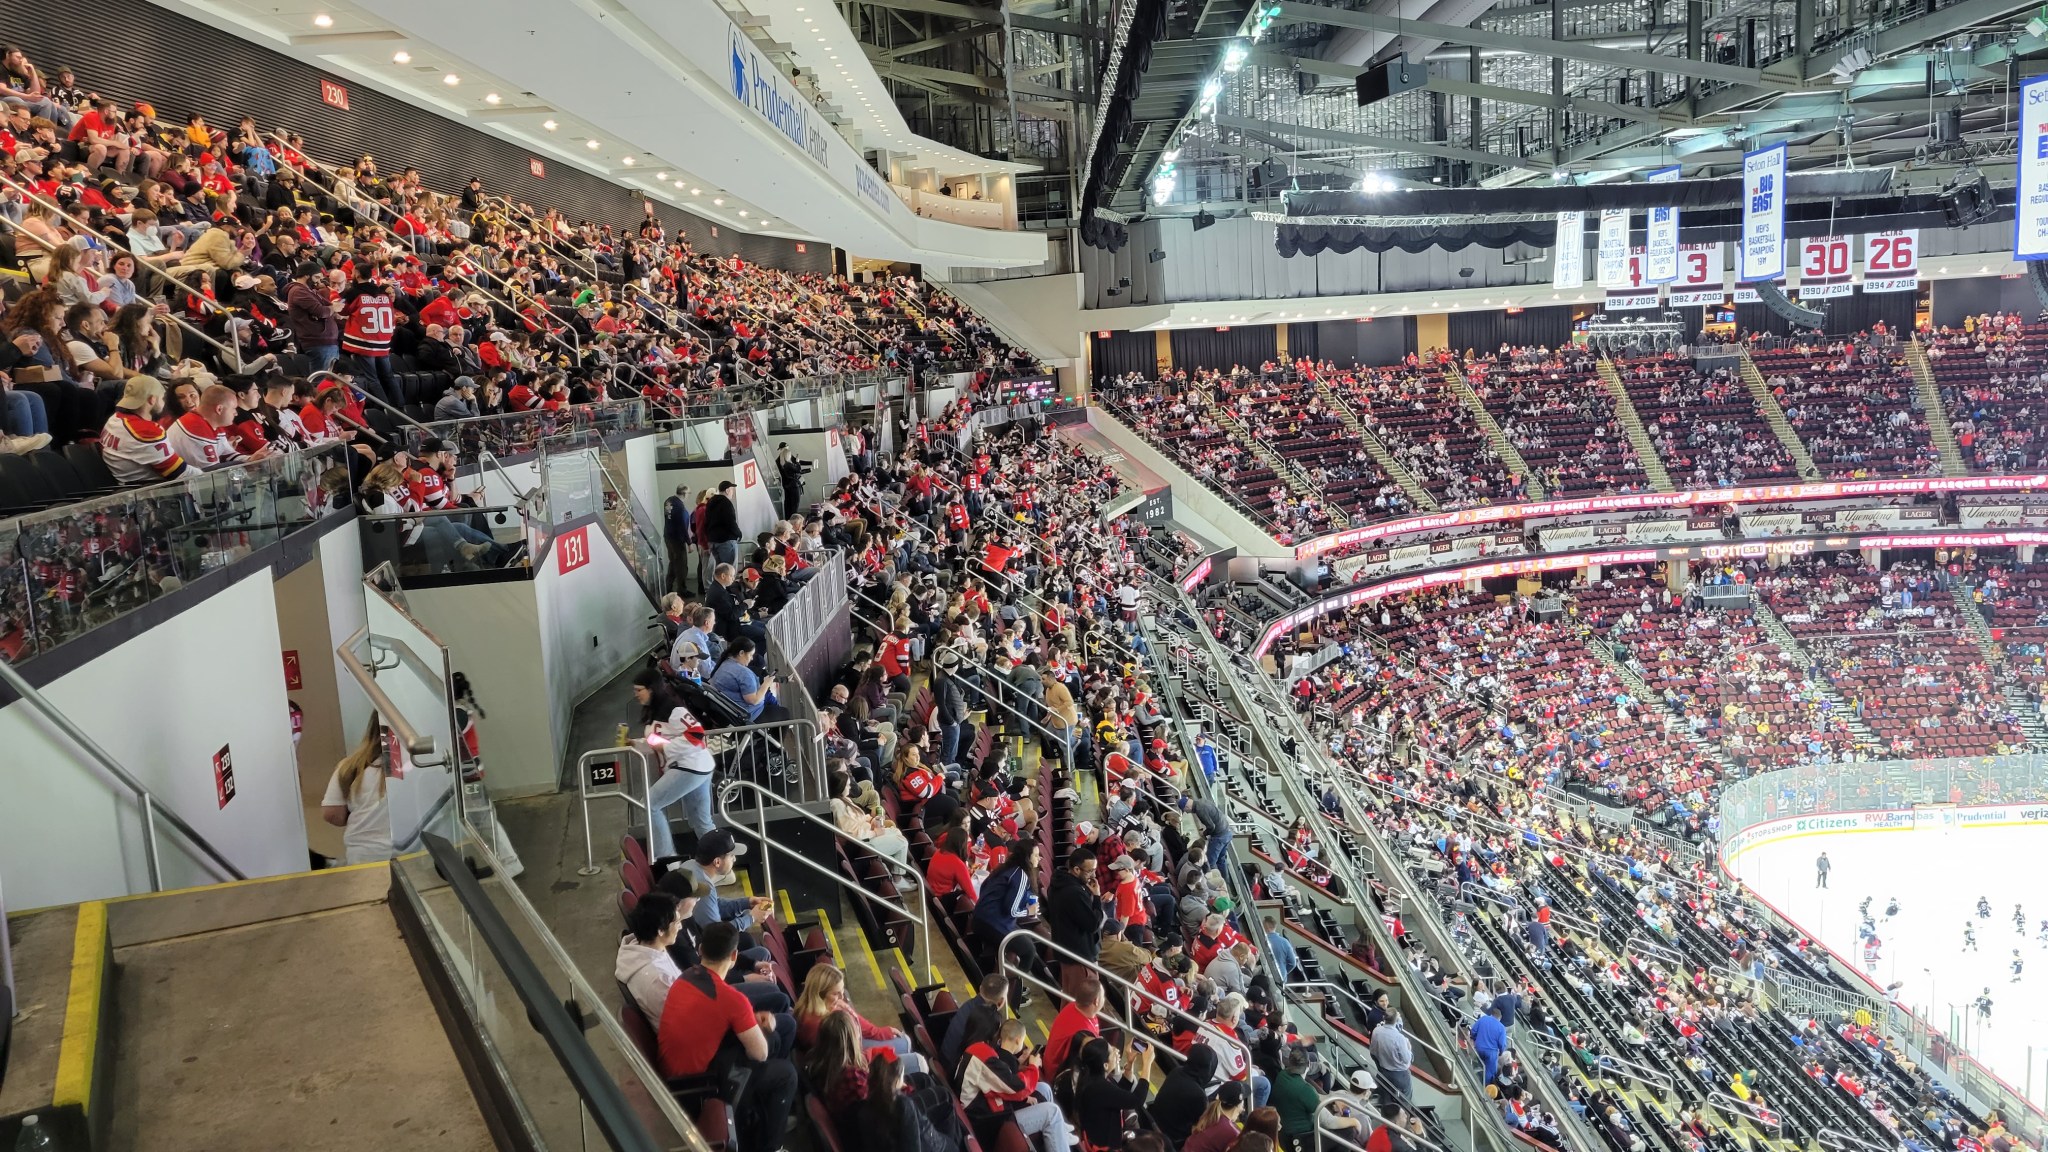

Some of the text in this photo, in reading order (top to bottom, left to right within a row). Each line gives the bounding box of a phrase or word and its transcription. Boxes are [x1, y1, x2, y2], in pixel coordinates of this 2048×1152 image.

[326, 85, 344, 105] 230
[750, 53, 829, 169] Prudential Center
[1747, 153, 1781, 173] Seton Hall
[1760, 174, 1774, 193] BIG
[1752, 193, 1773, 213] EAST
[1655, 207, 1671, 222] EAST
[1748, 235, 1776, 246] BASKETBALL
[1805, 242, 1848, 276] 30
[1870, 236, 1913, 270] 26
[1687, 253, 1708, 283] 3
[1802, 285, 1850, 295] 1990 2014
[1866, 279, 1915, 290] 1994 2016
[361, 294, 390, 305] BRODEUR
[1608, 297, 1656, 306] 1991 2005
[1671, 293, 1723, 303] 1982 2003
[1737, 291, 1754, 299] 1991
[360, 306, 393, 334] 30
[155, 443, 170, 457] 7
[423, 474, 440, 487] 96
[1842, 483, 1876, 493] YOUTH
[1879, 481, 1926, 491] HOCKEY
[1929, 479, 1986, 489] MARQUEE
[1149, 497, 1162, 508] EST.
[1521, 504, 1552, 514] YOUTH
[1554, 501, 1590, 511] HOCKEY
[1593, 497, 1642, 508] MARQUEE
[1145, 506, 1165, 520] 1982
[1844, 509, 1893, 522] Yuengling
[1967, 507, 2020, 519] Yuengling
[1635, 521, 1716, 535] Yuengling LAGER
[1747, 515, 1796, 528] Yuengling
[1338, 532, 1359, 544] YOUTH
[1360, 527, 1386, 539] HOCKEY
[1387, 520, 1421, 533] MARQUEE
[1544, 528, 1589, 541] Yuengling
[1498, 536, 1519, 544] LAGER
[1893, 537, 1941, 546] HOCKEY
[565, 534, 584, 567] 131
[1393, 545, 1450, 560] Yuengling LAGER
[1722, 544, 1741, 557] PIT
[1368, 554, 1387, 563] LAGER
[1589, 555, 1621, 564] YOUTH
[220, 752, 231, 772] 233
[592, 768, 615, 780] 132
[224, 777, 235, 795] 132
[909, 776, 925, 789] 86
[1865, 812, 1934, 822] RWJBarnabas
[1957, 811, 2006, 821] Prudential
[1809, 817, 1858, 830] Citizens
